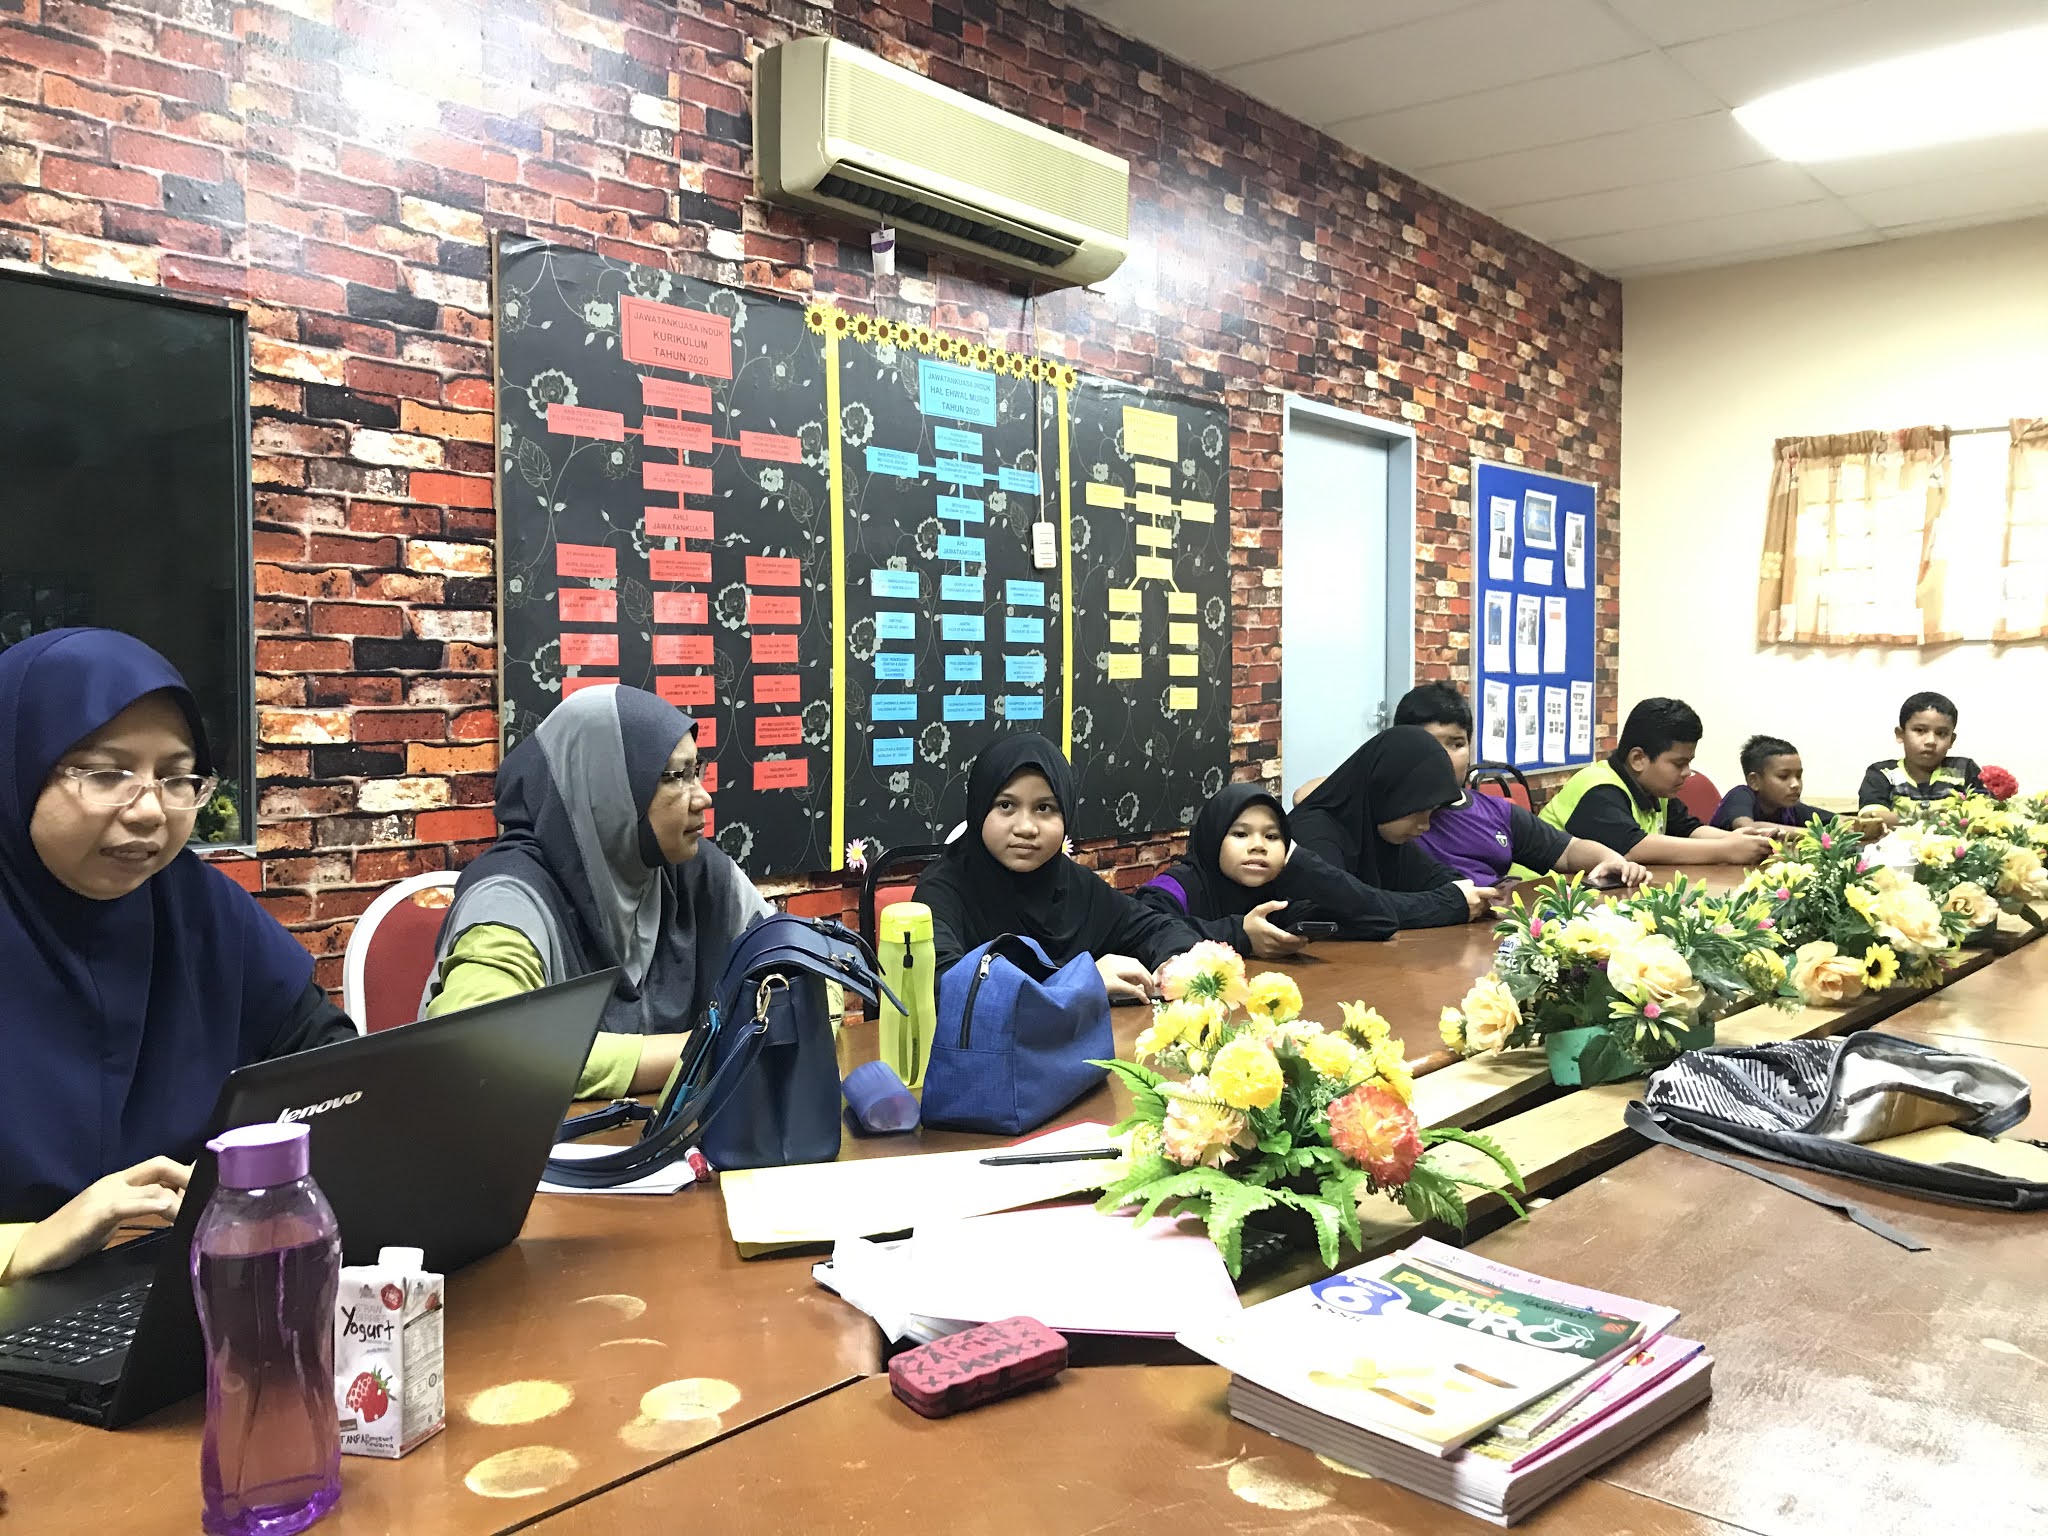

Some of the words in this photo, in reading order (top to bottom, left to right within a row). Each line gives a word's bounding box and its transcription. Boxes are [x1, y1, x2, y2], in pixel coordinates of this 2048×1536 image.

[634, 312, 699, 333] JAWATANKUASA
[701, 327, 724, 338] INDUK
[653, 330, 708, 350] KURIKULUM
[653, 347, 686, 362] TAHUN
[688, 354, 709, 366] 2020
[928, 373, 973, 388] JAWATANKUASA
[930, 386, 944, 396] HAL
[945, 389, 968, 400] EHWAL
[970, 394, 989, 404] MURID
[942, 402, 965, 413] TAHUN
[966, 407, 980, 416] 2020
[653, 523, 708, 532] JAWATANKUASA
[1321, 1286, 1375, 1311] 6
[341, 1306, 394, 1342] Yogurt
[1428, 1300, 1580, 1349] PRO
